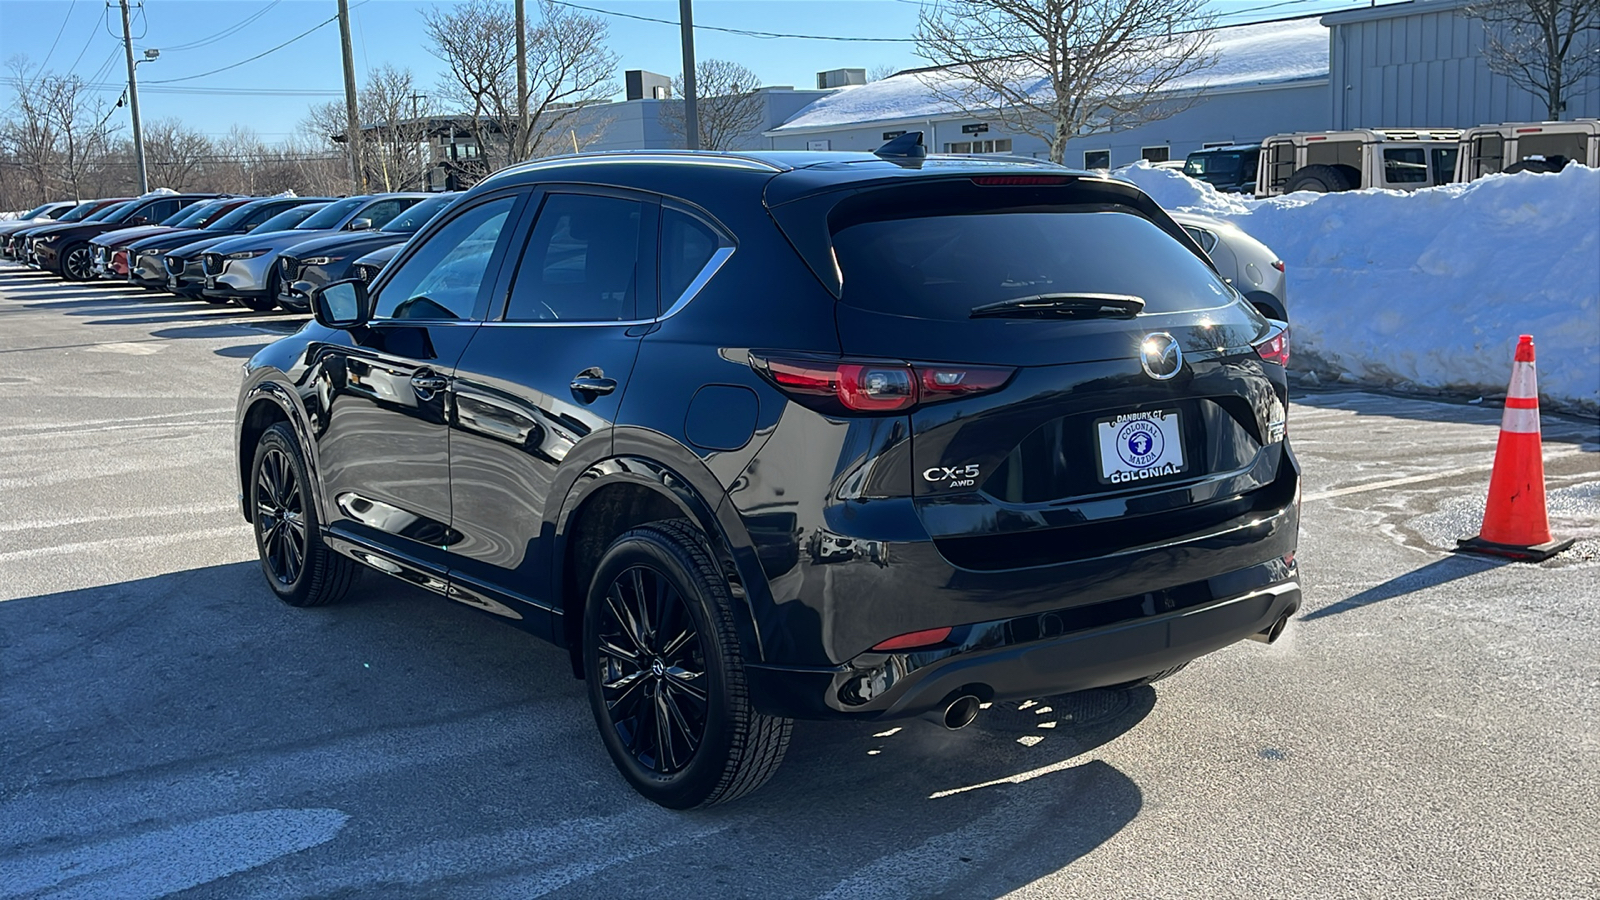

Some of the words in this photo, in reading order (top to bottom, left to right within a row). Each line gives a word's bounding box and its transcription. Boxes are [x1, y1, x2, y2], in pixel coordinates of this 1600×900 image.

[1152, 409, 1162, 418] CT
[1121, 422, 1158, 440] COLONIAL
[1128, 451, 1157, 465] MAZDA
[922, 464, 980, 482] CX-5
[1110, 464, 1181, 484] COLONIAL
[949, 479, 975, 488] AWD
